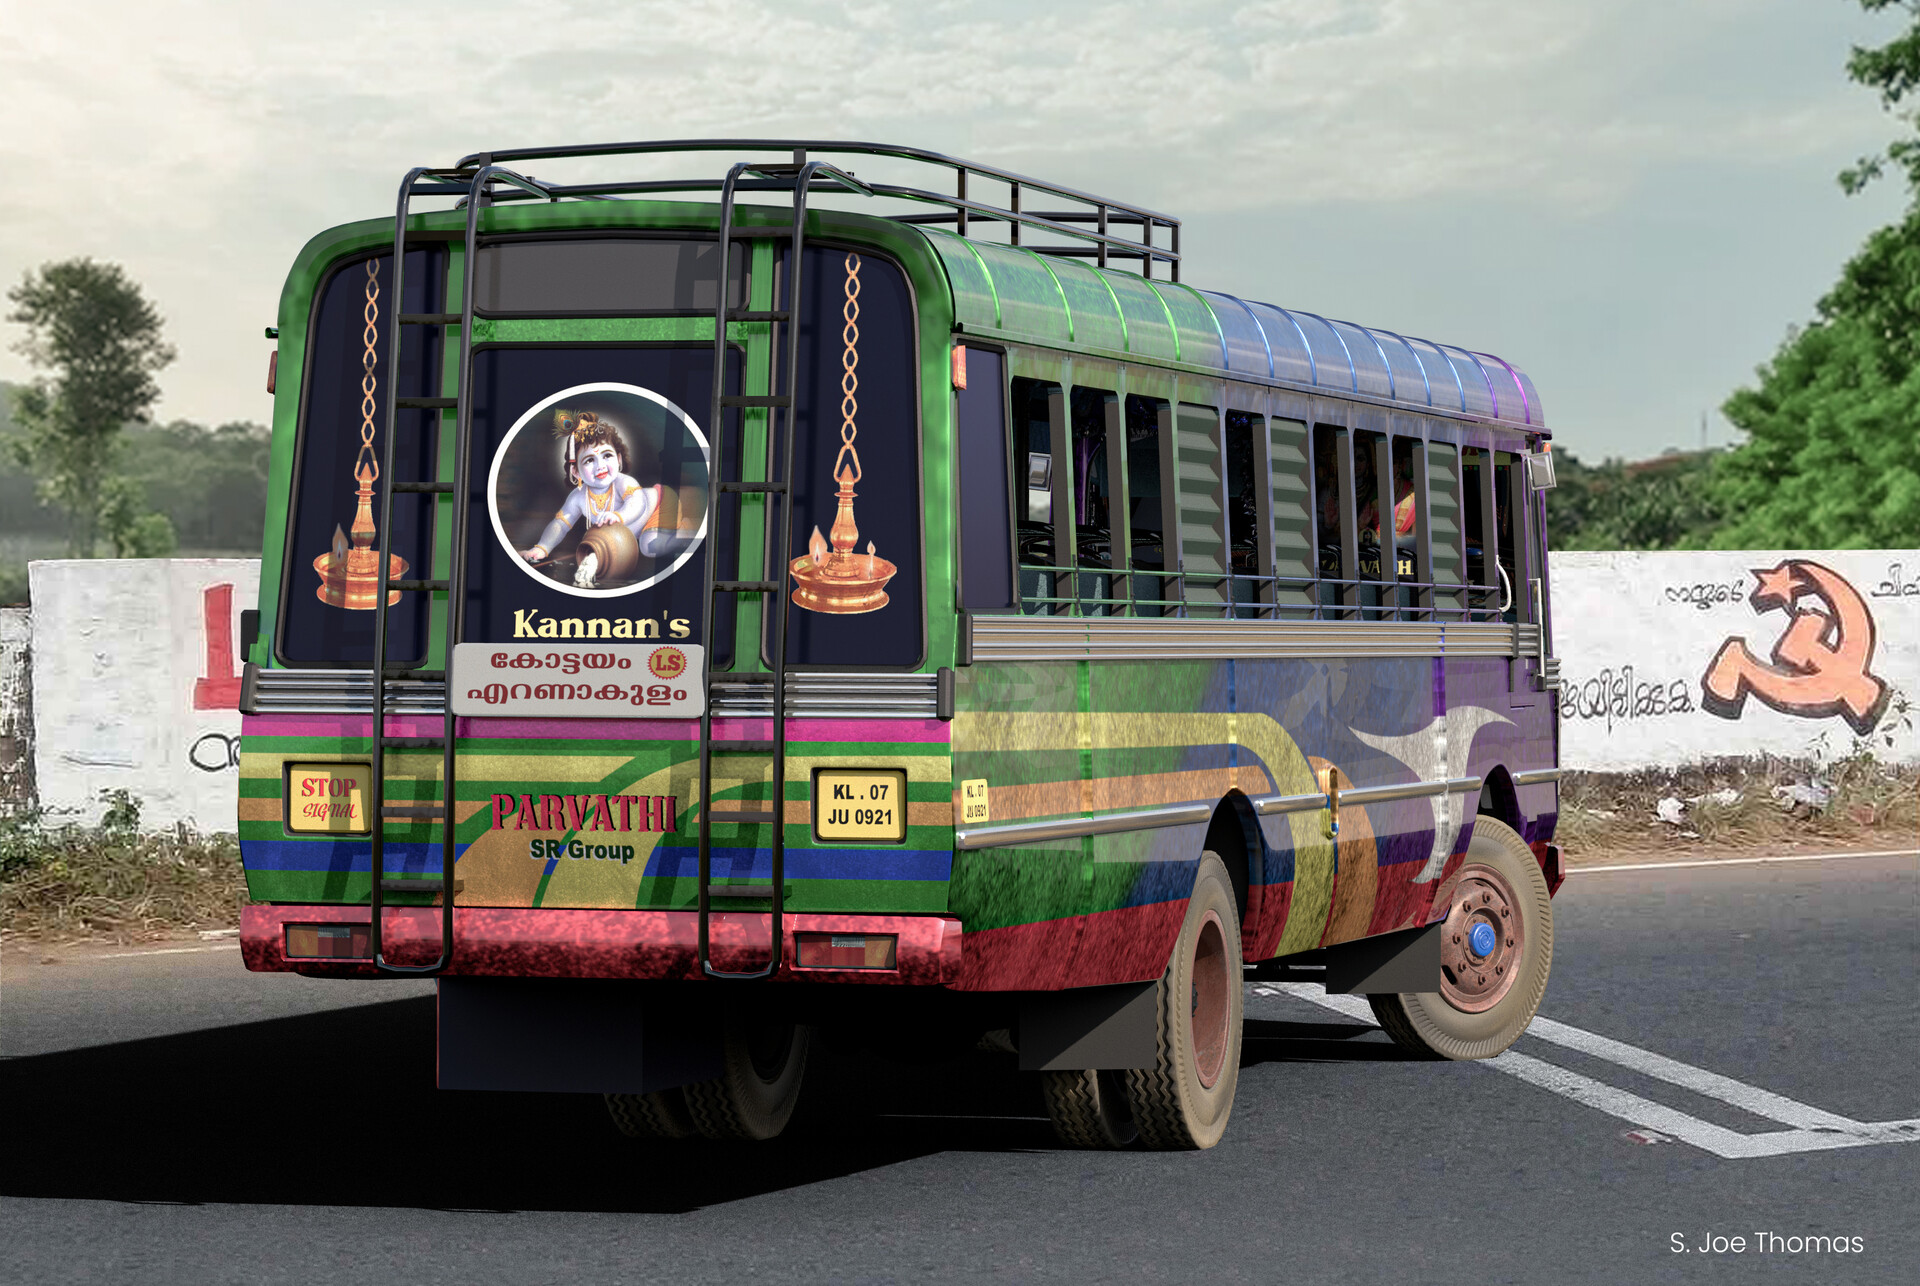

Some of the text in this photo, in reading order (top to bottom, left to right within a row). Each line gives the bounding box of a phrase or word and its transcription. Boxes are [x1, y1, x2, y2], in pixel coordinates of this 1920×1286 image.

[513, 608, 691, 639] Kannan's
[490, 652, 632, 675] കോട്ടയം
[467, 683, 688, 706] എറണാകുളം
[301, 777, 357, 797] STOP
[833, 784, 855, 800] KL
[869, 784, 889, 800] 07
[490, 793, 677, 833] PARVATHI
[828, 809, 892, 825] JU 0921
[529, 839, 635, 865] SR Group
